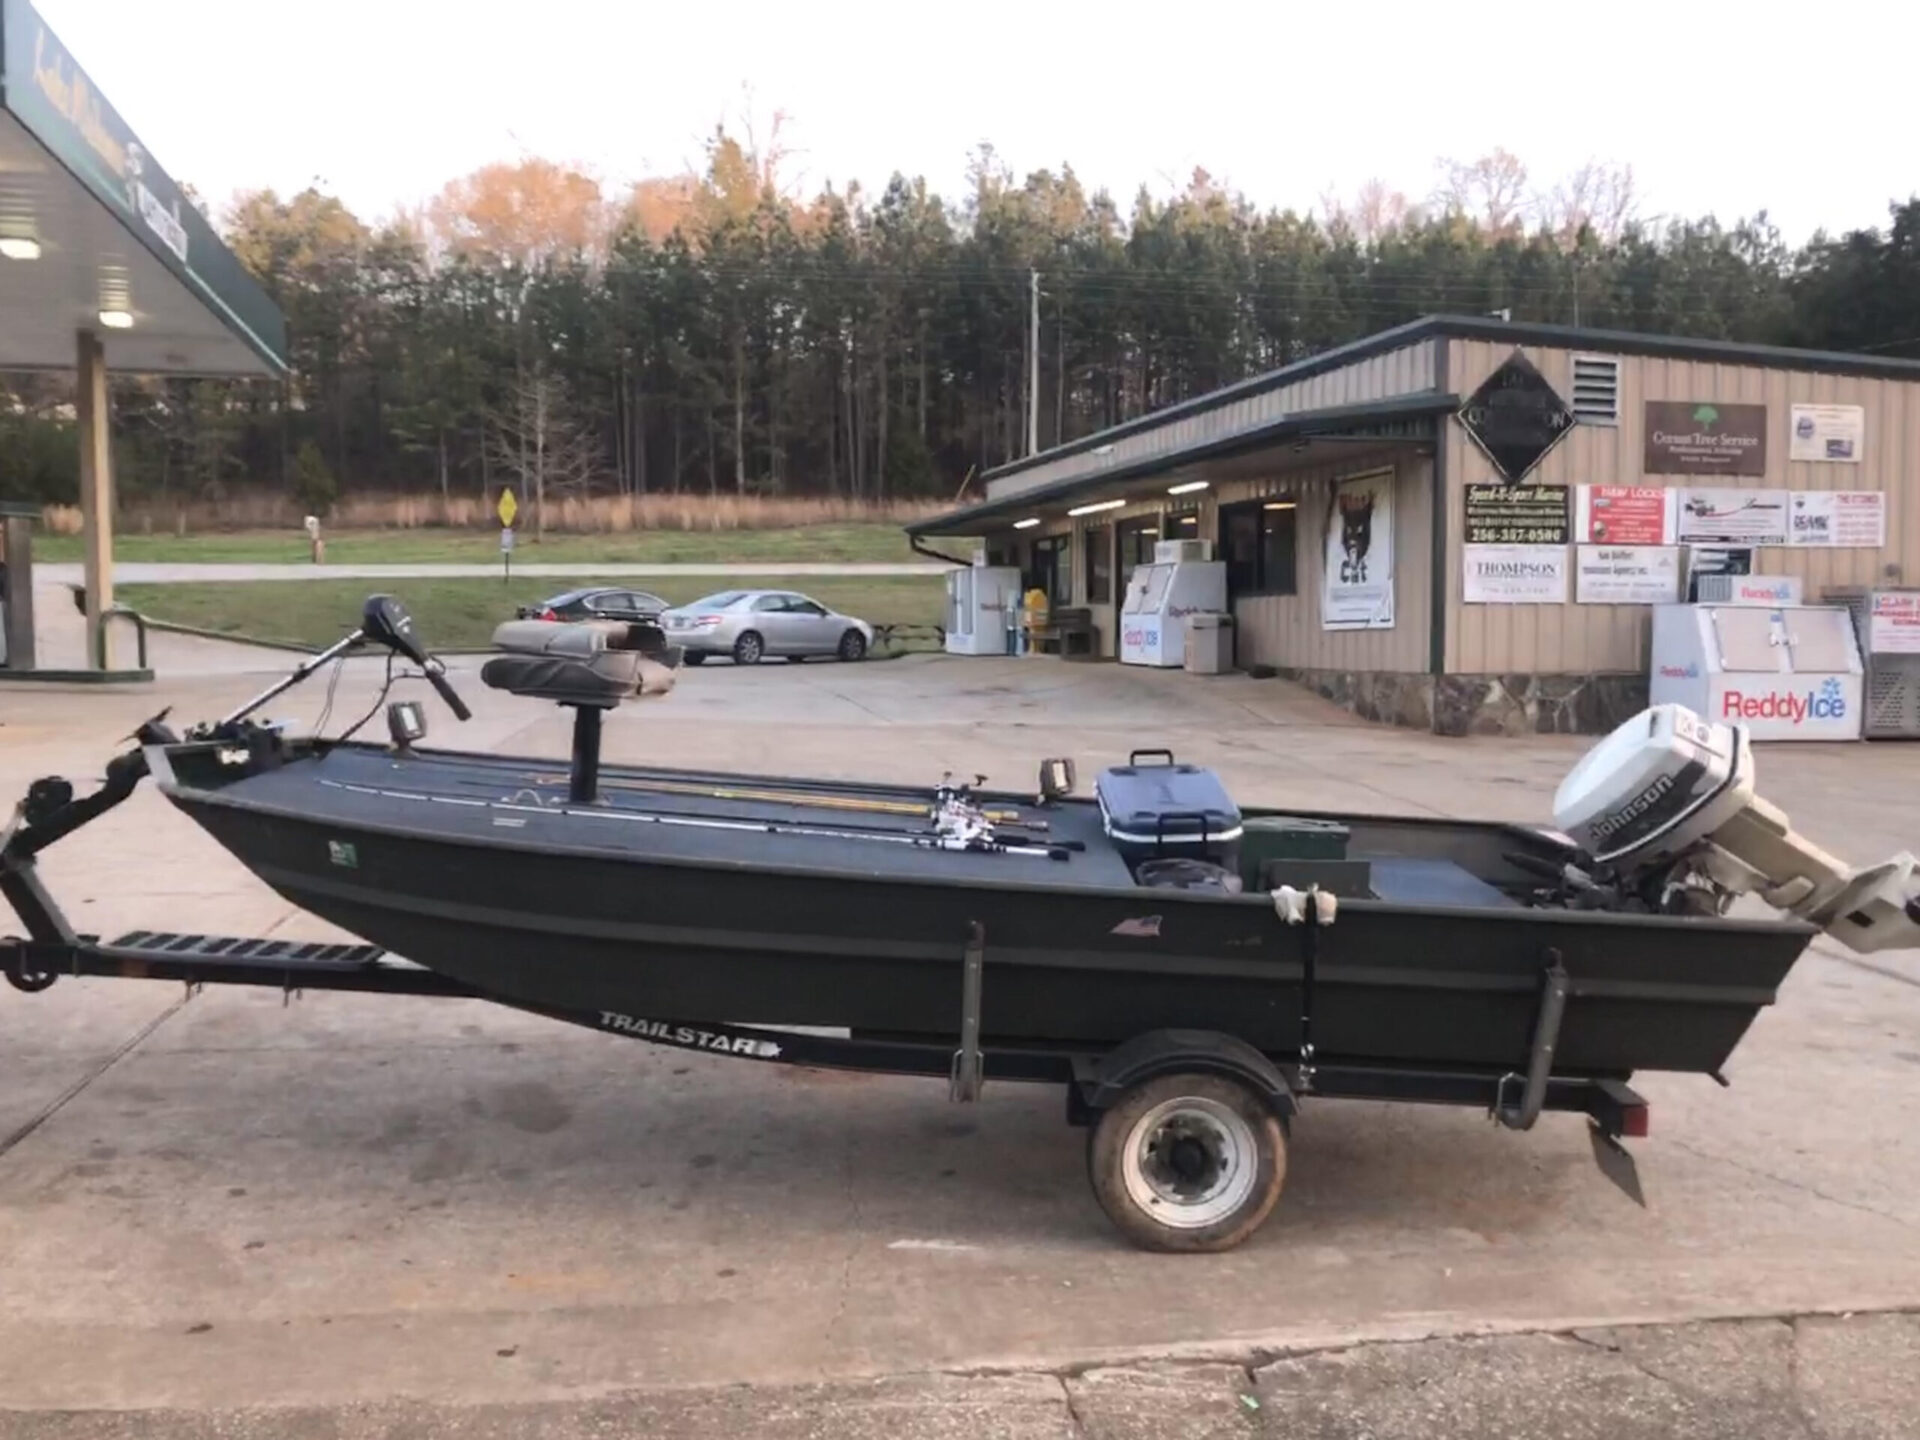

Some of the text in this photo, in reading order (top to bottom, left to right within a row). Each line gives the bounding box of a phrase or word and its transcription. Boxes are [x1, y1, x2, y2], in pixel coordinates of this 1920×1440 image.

[1720, 433, 1759, 446] Service
[1477, 562, 1555, 575] THOMPSON
[1723, 690, 1846, 724] ReddyIce
[1590, 773, 1675, 841] Johnson
[599, 1010, 757, 1056] TRAILSTAR
